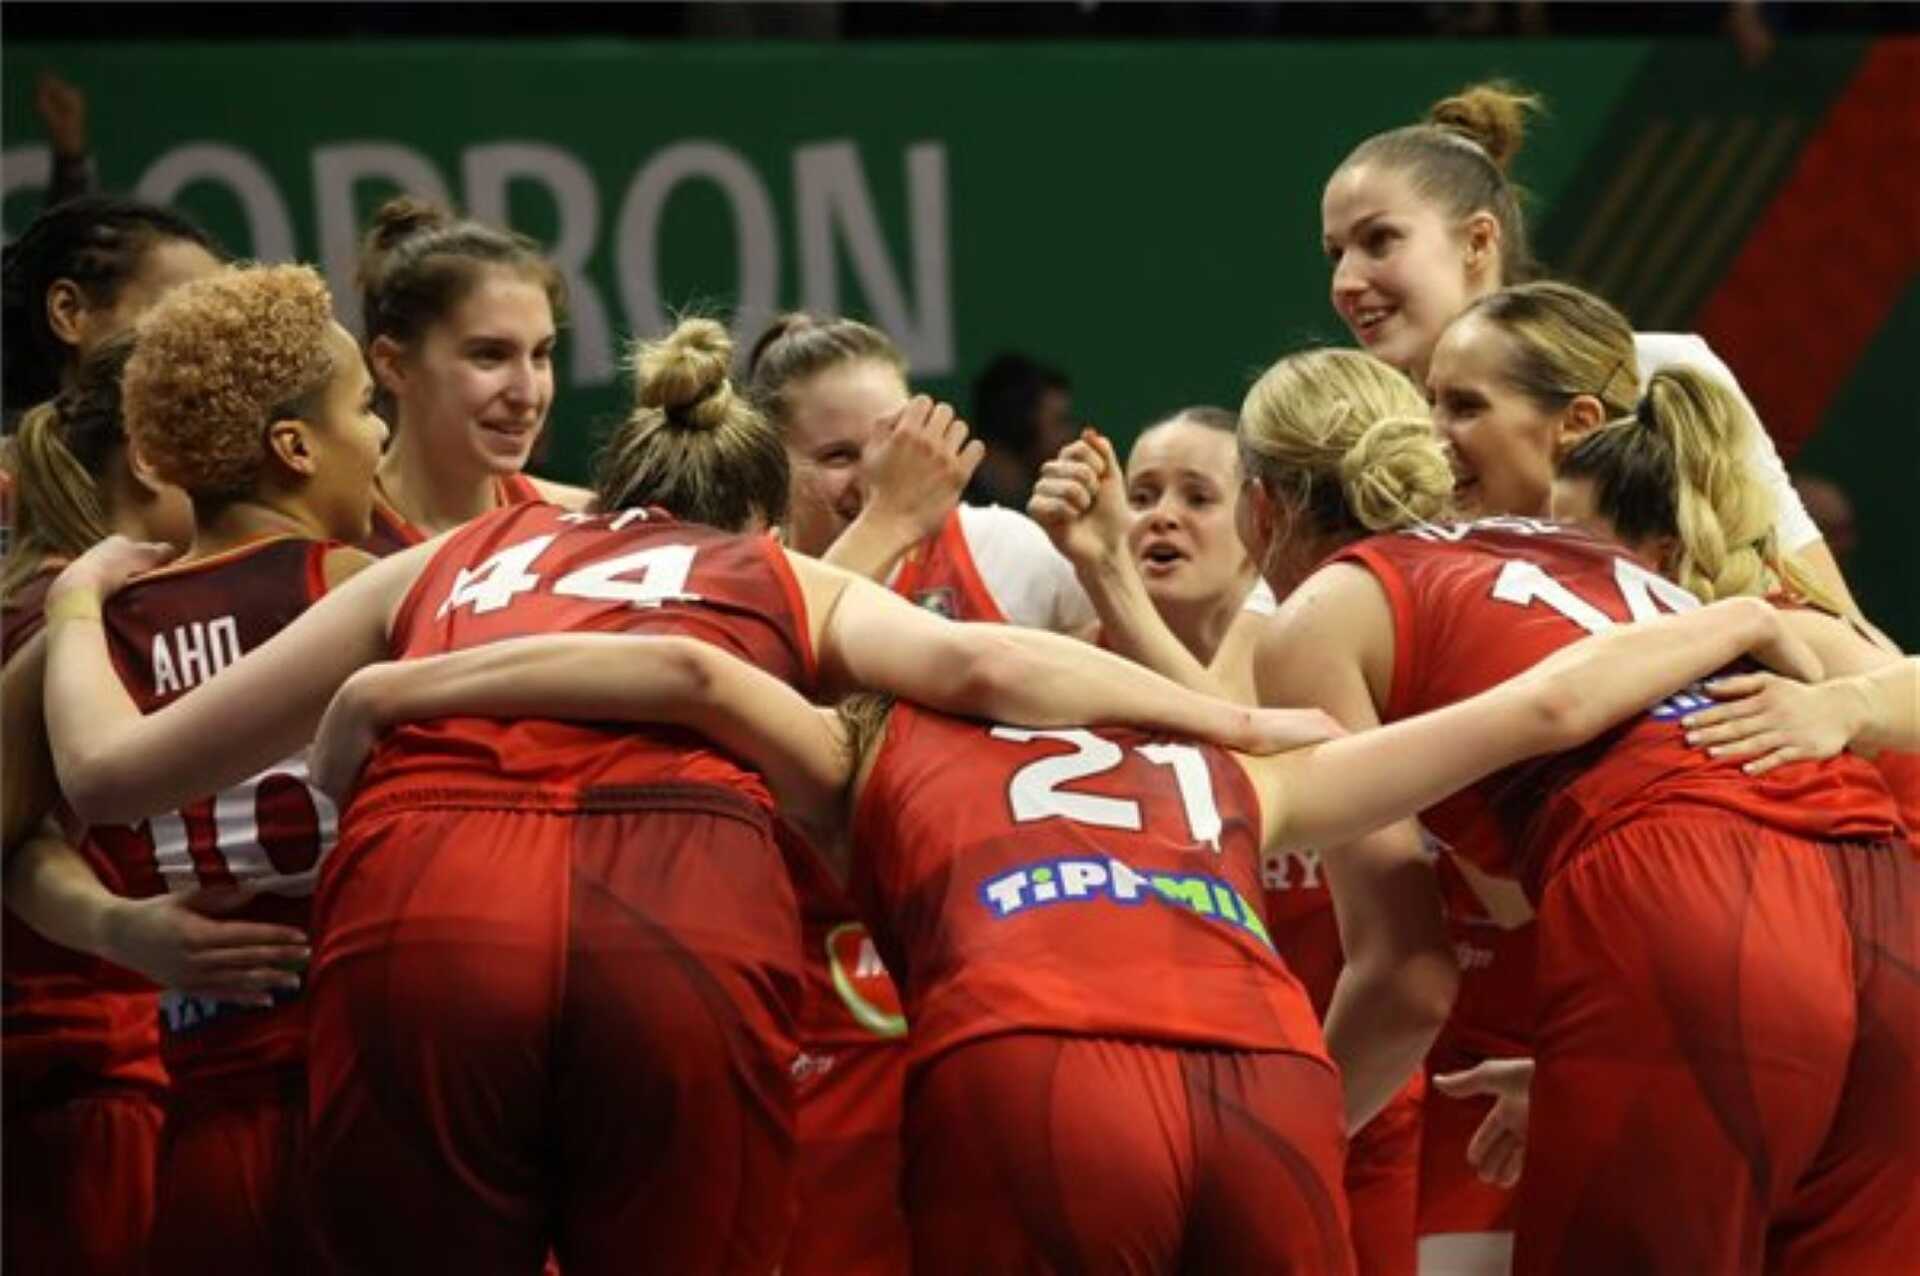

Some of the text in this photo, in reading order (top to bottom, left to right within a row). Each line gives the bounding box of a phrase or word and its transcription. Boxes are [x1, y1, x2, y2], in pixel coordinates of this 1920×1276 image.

[434, 533, 704, 615] 44
[1492, 556, 1703, 636] 14
[989, 725, 1222, 854] 21
